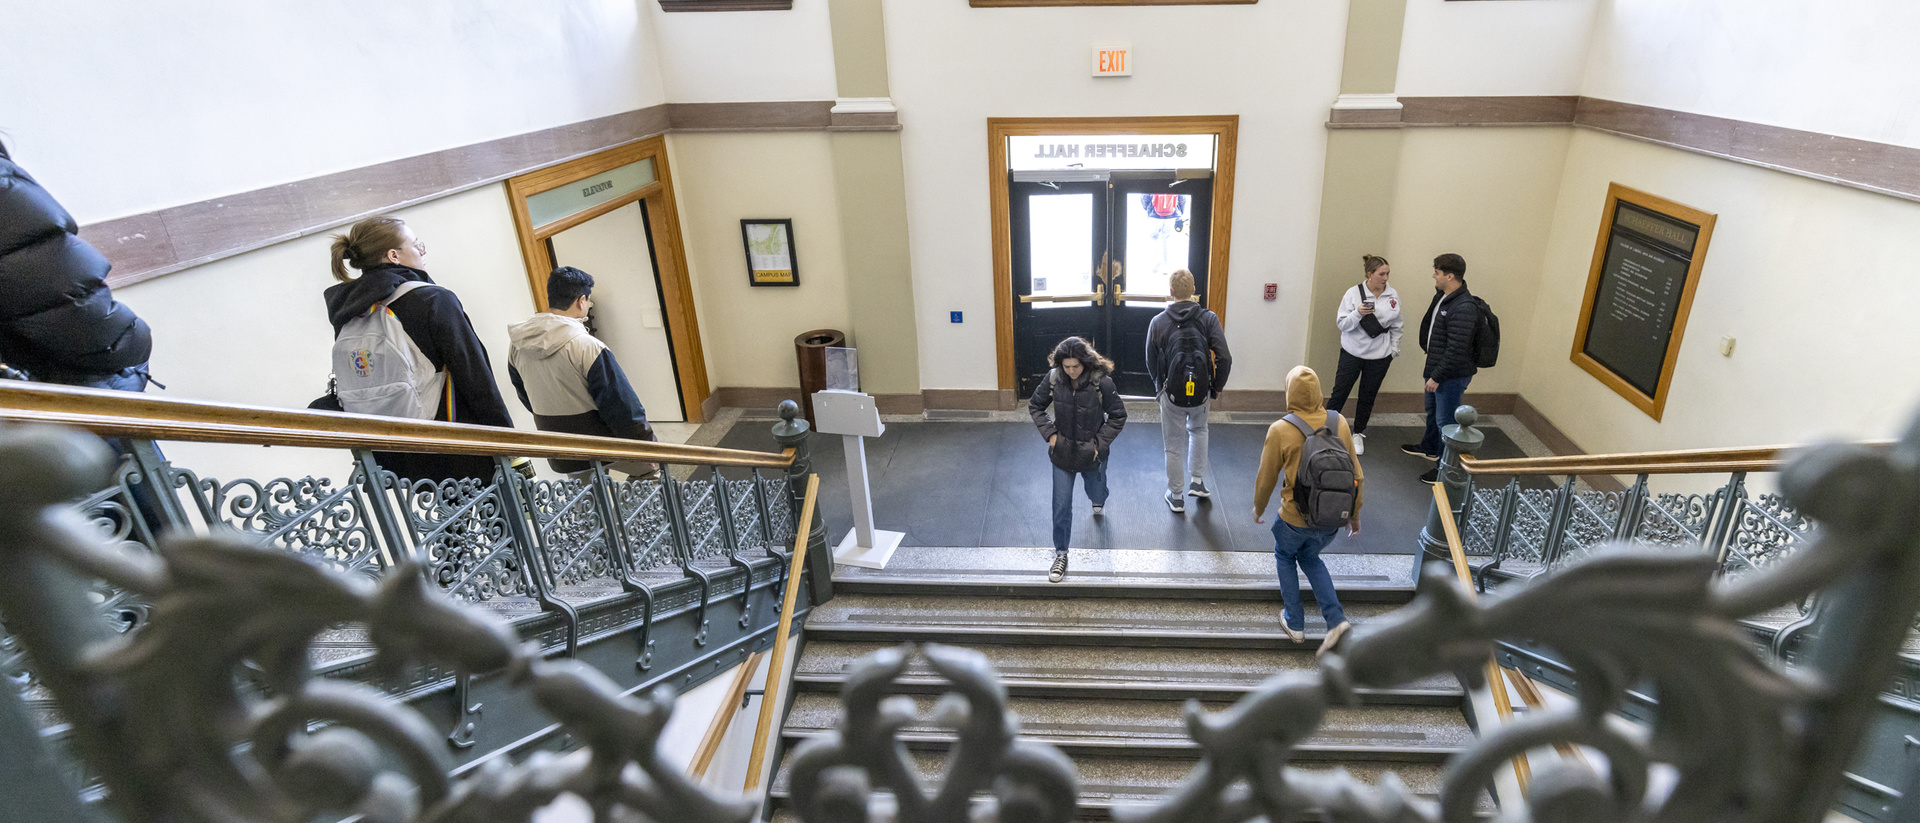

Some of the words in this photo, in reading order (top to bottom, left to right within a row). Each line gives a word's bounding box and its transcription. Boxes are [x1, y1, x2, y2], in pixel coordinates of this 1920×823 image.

[1099, 50, 1127, 72] EXIT
[582, 180, 613, 197] ELEVATOR
[1665, 228, 1686, 243] HALL
